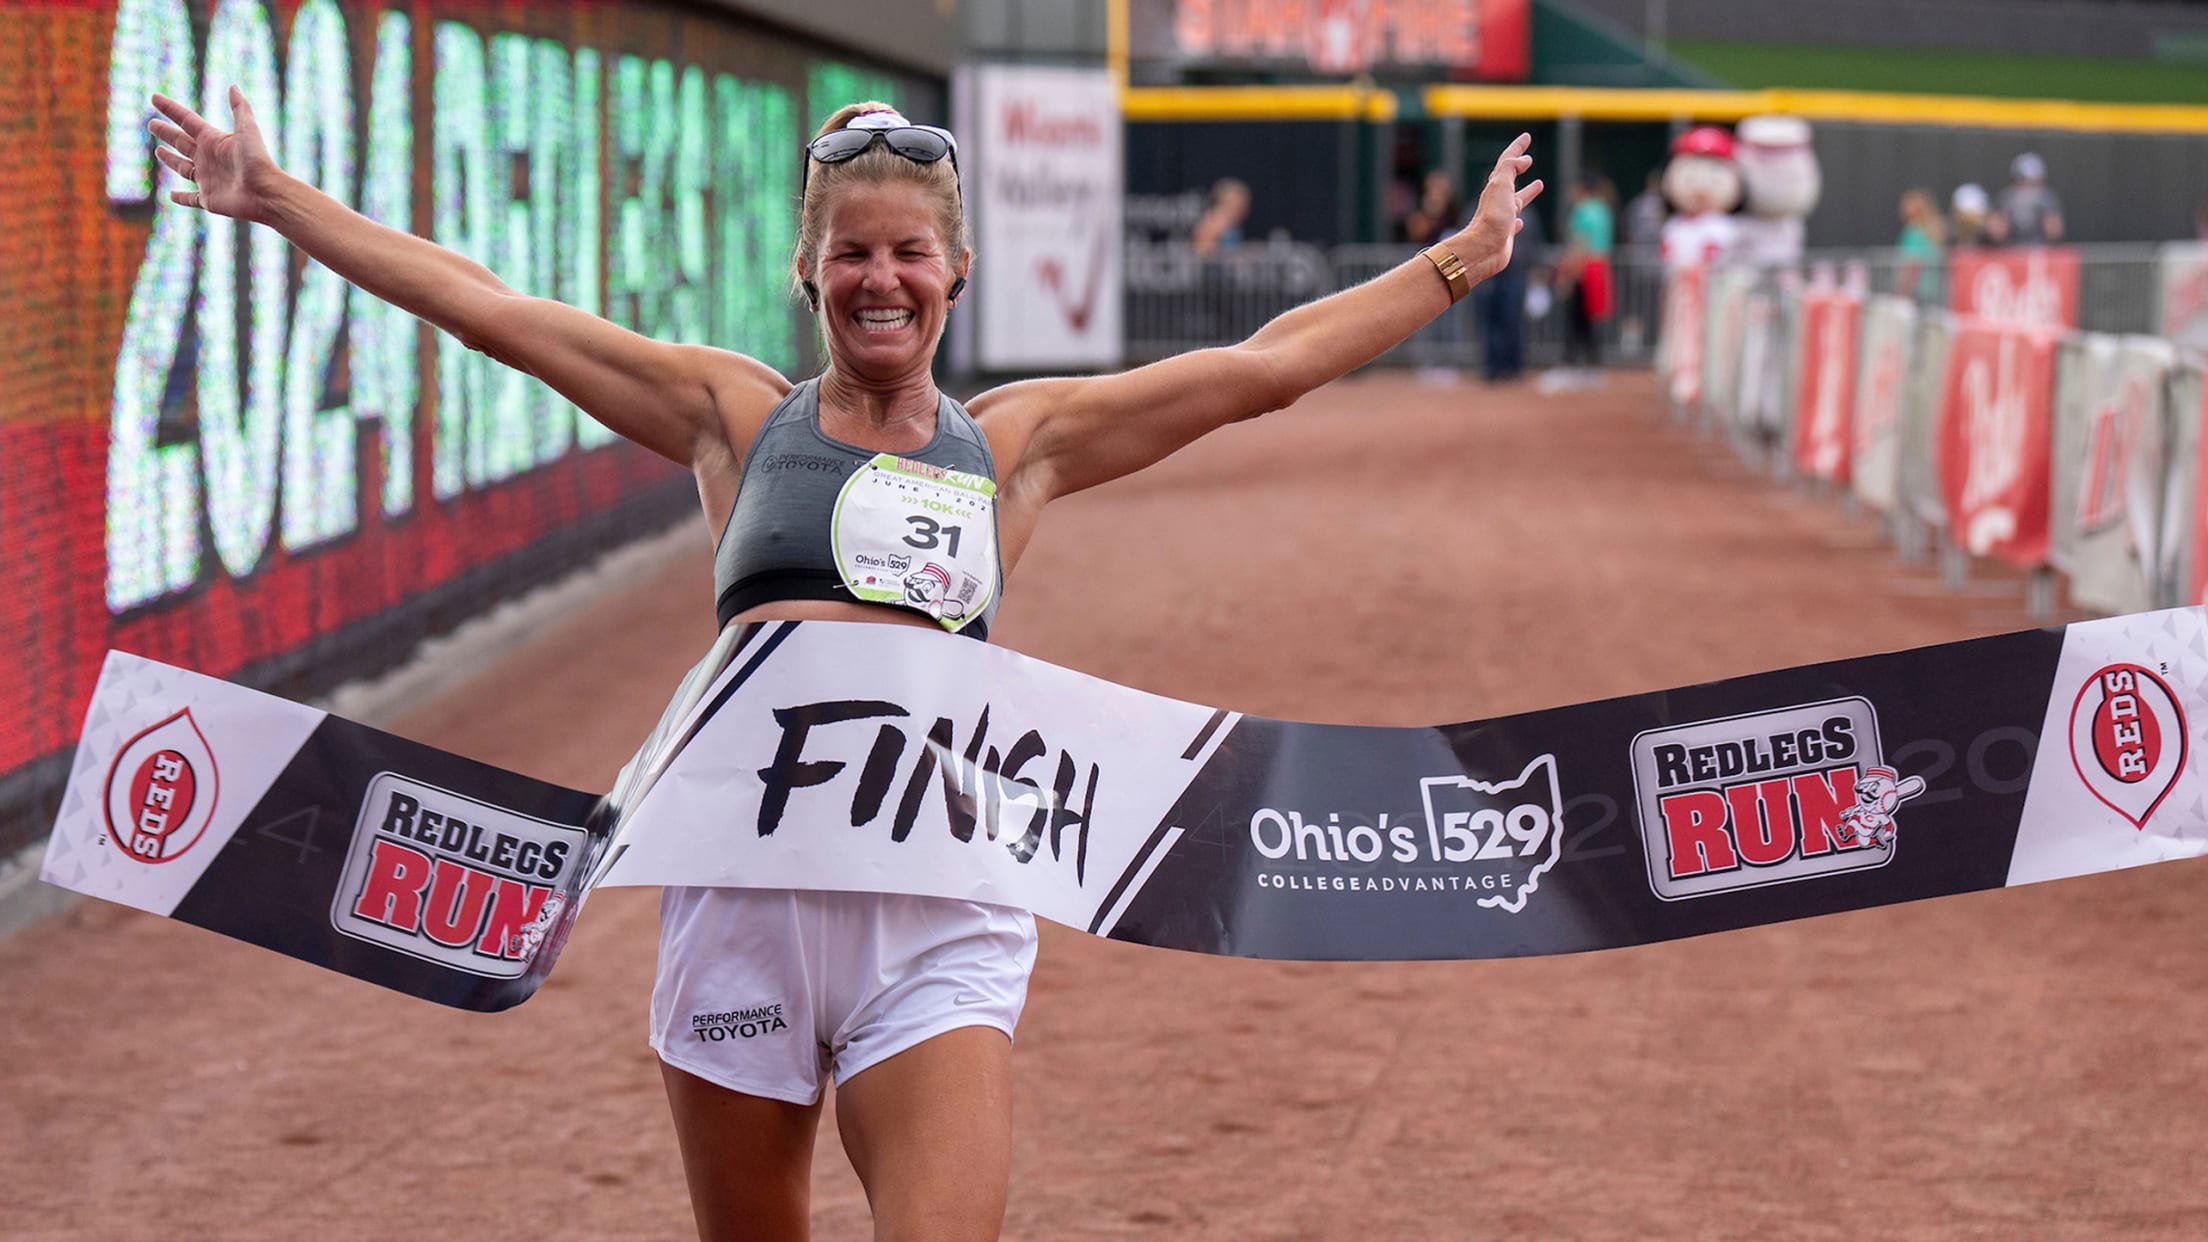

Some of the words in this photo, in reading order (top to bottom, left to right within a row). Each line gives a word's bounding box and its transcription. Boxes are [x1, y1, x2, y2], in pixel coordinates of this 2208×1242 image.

[104, 0, 417, 616] 2024
[778, 461, 842, 476] TOYOTA
[872, 478, 920, 493] JUNE
[896, 456, 948, 482] REDLEGS
[946, 470, 985, 491] RUN
[904, 478, 951, 495] AMERICAN
[953, 489, 977, 501] BALL
[921, 499, 954, 515] 10K
[901, 514, 962, 559] 31
[855, 554, 886, 568] Ohio's
[889, 559, 908, 570] 529
[2106, 669, 2148, 777] REDS
[1653, 716, 1857, 790] REDLEGS
[132, 754, 184, 858] REDS
[757, 700, 1098, 888] FINISH
[381, 791, 571, 880] REDLEGS
[1250, 808, 1418, 863] Ohio's
[1444, 804, 1550, 862] 529
[1662, 770, 1862, 880] RUN
[353, 840, 556, 960] RUN
[1257, 873, 1513, 892] COLLEGEADVANTAGE
[692, 1003, 782, 1026] PERFORMANCE
[694, 1016, 787, 1042] TOYOTA
